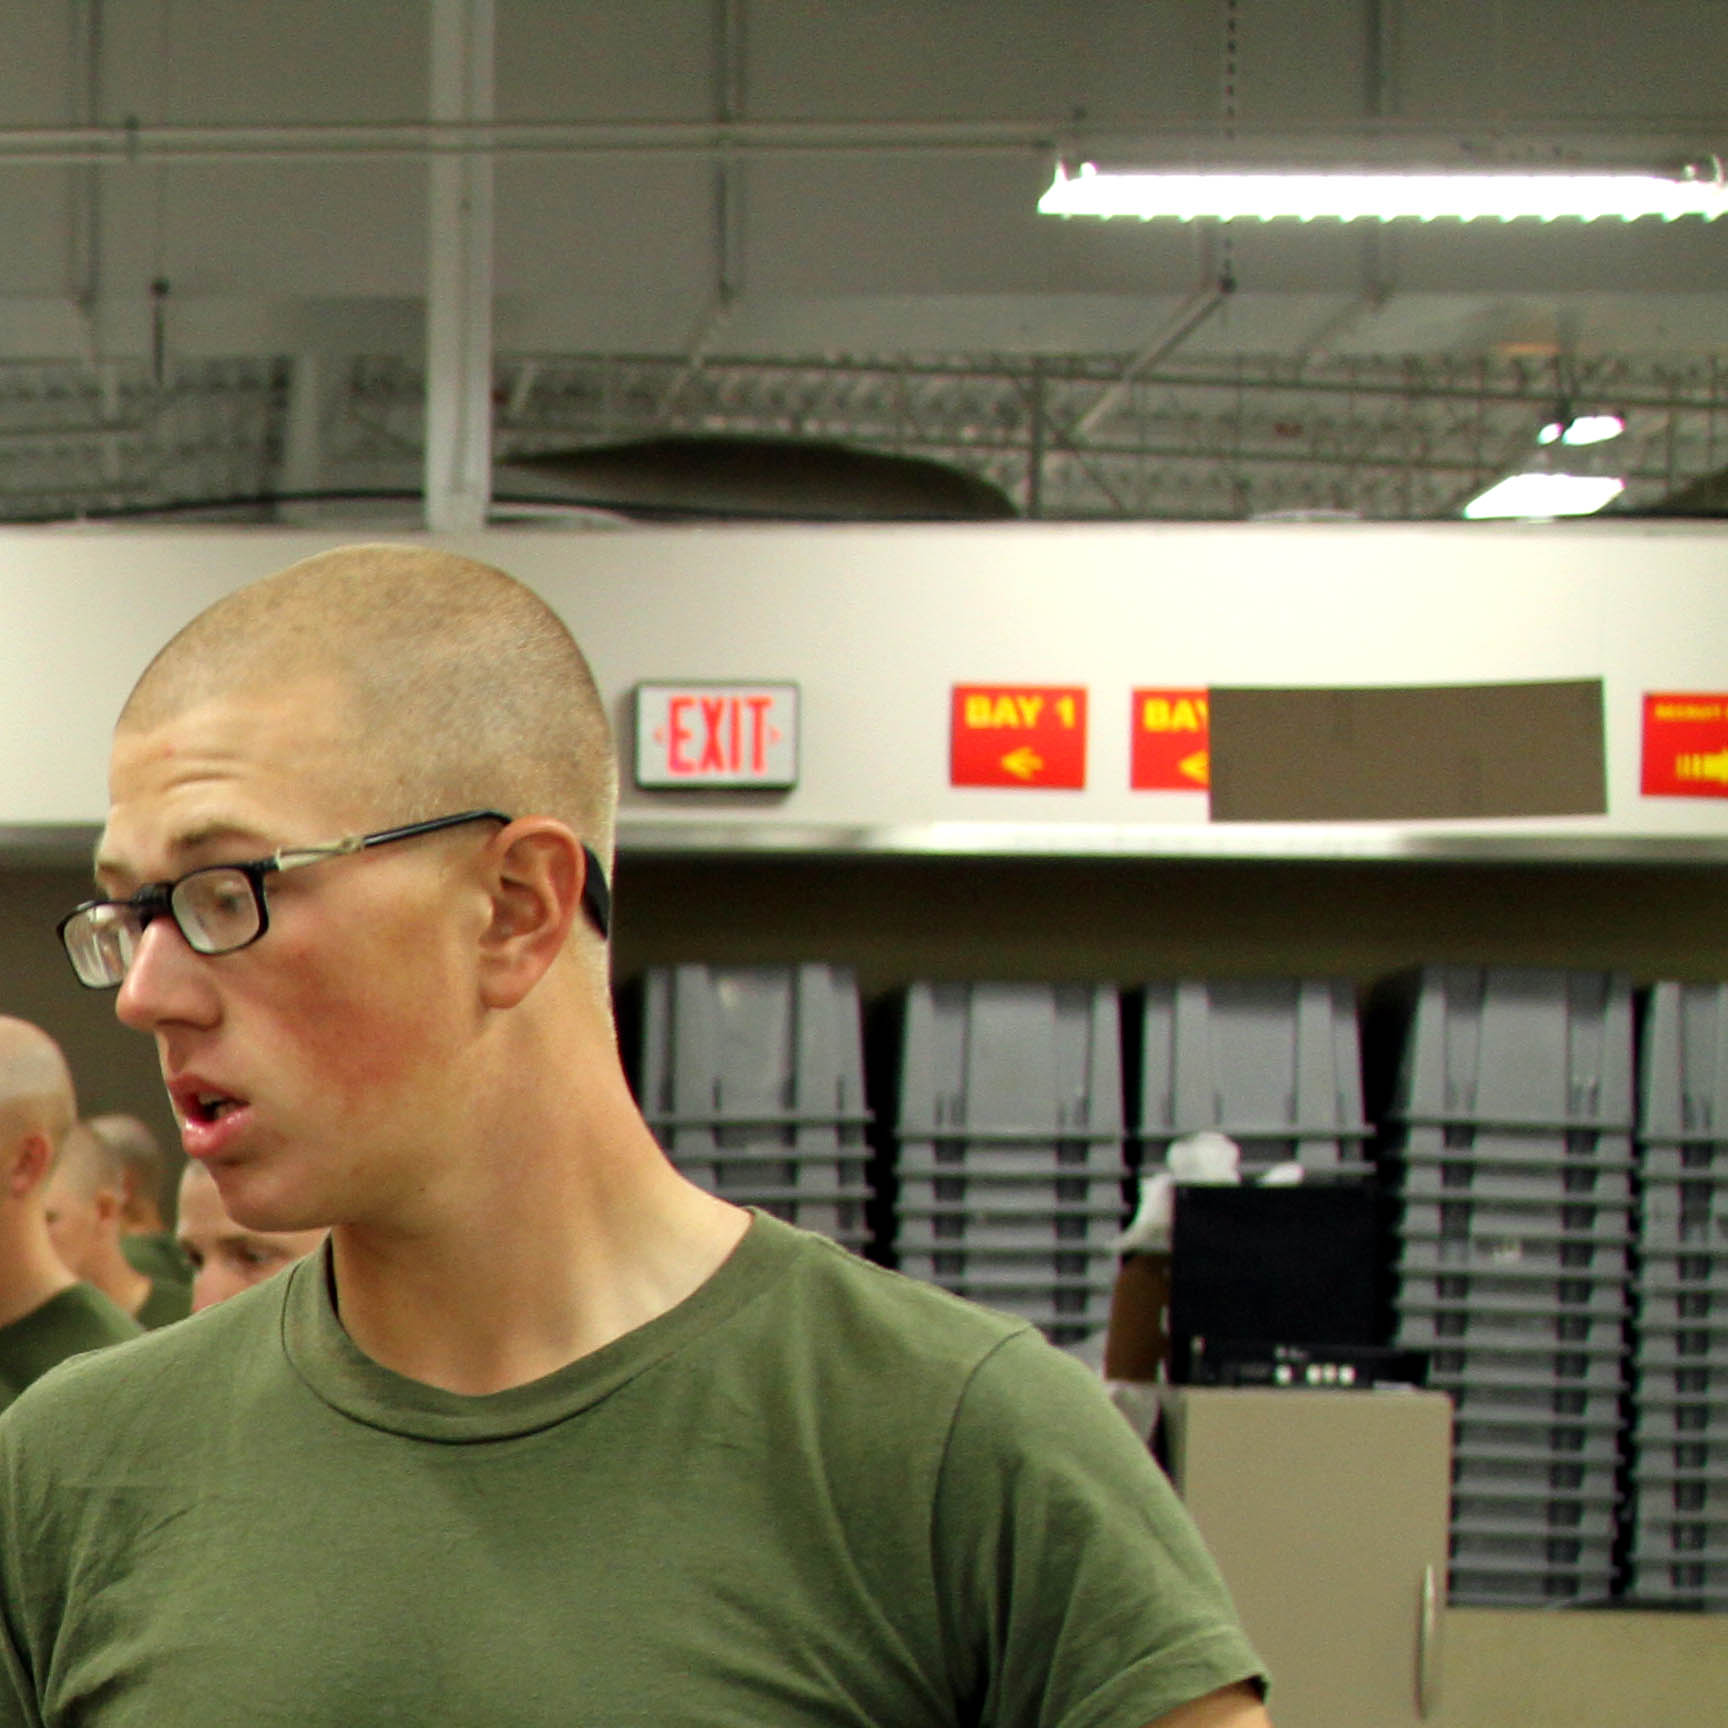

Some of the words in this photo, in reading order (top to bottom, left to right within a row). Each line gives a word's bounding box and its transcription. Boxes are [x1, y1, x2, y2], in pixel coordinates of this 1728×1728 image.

[666, 695, 776, 775] EXIT
[965, 695, 1039, 727] BAY
[1057, 695, 1076, 727] 1
